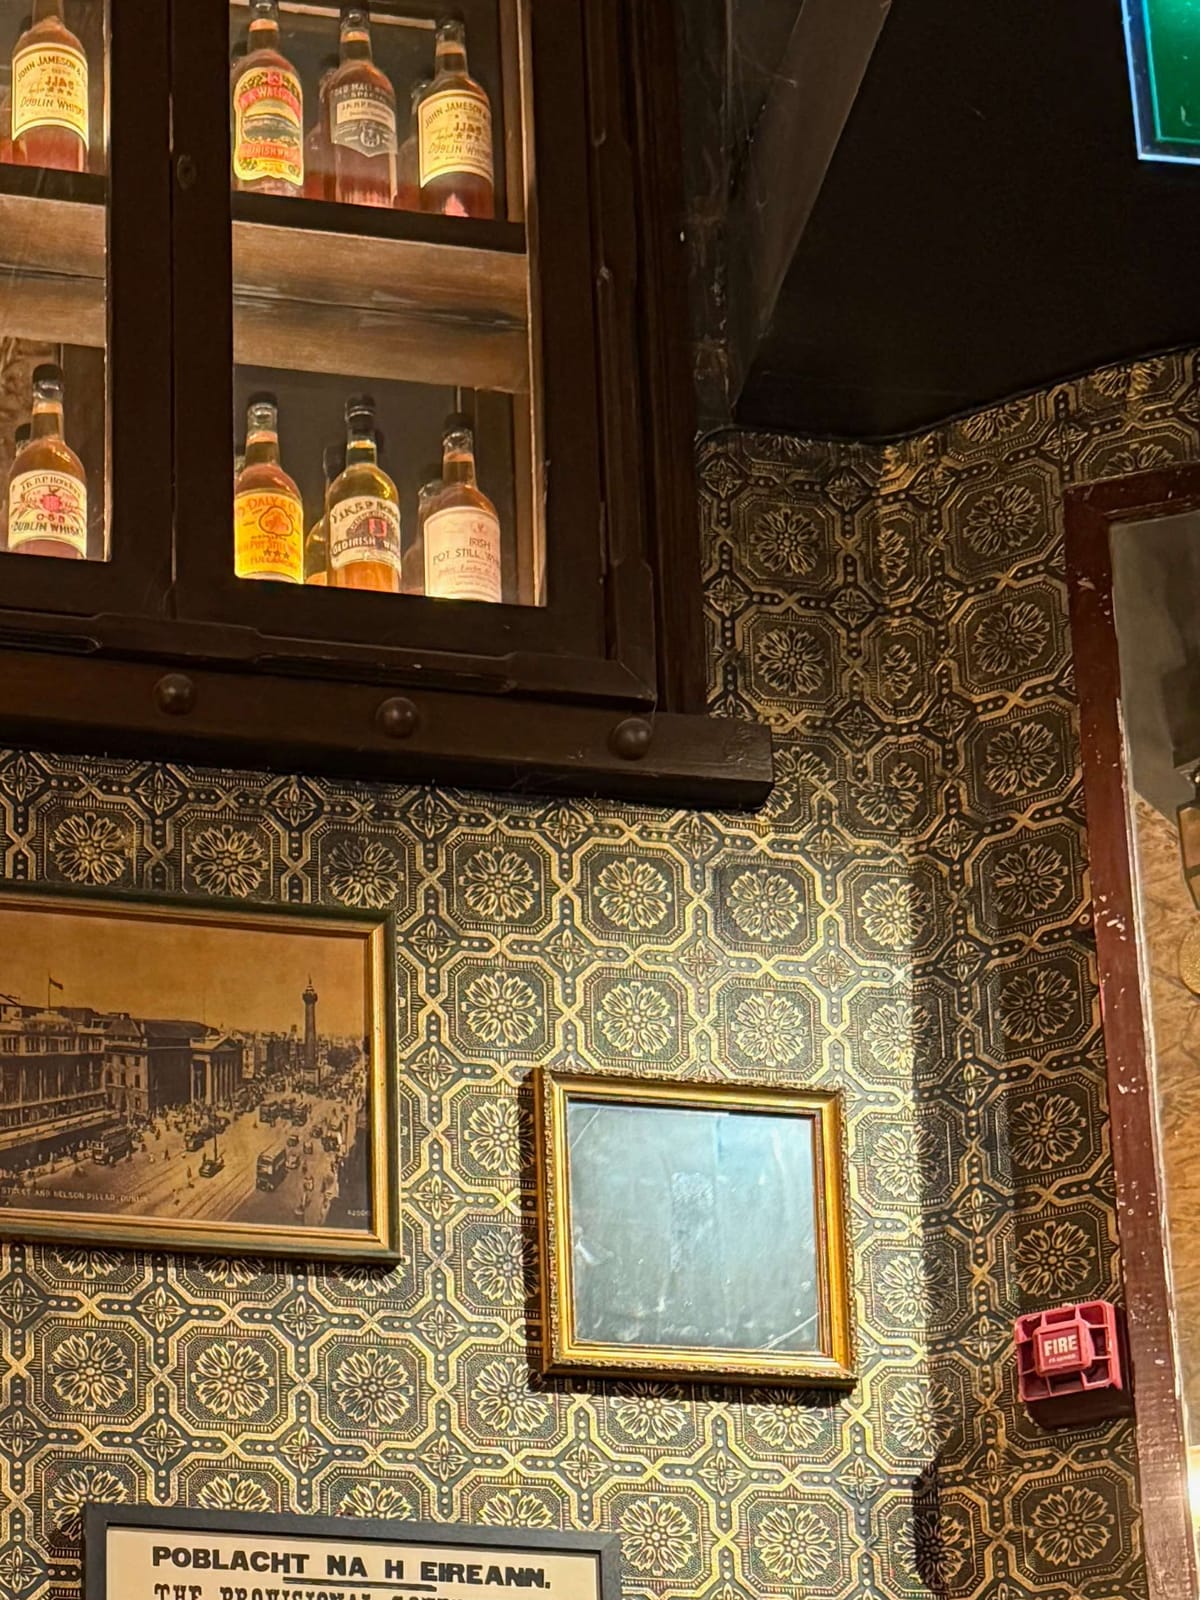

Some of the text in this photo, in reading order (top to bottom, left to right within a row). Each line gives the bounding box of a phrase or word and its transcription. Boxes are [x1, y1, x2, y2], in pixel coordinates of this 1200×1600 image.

[1043, 1334, 1079, 1357] FIRE
[152, 1545, 550, 1589] POBLACHT NA H EIREANN.
